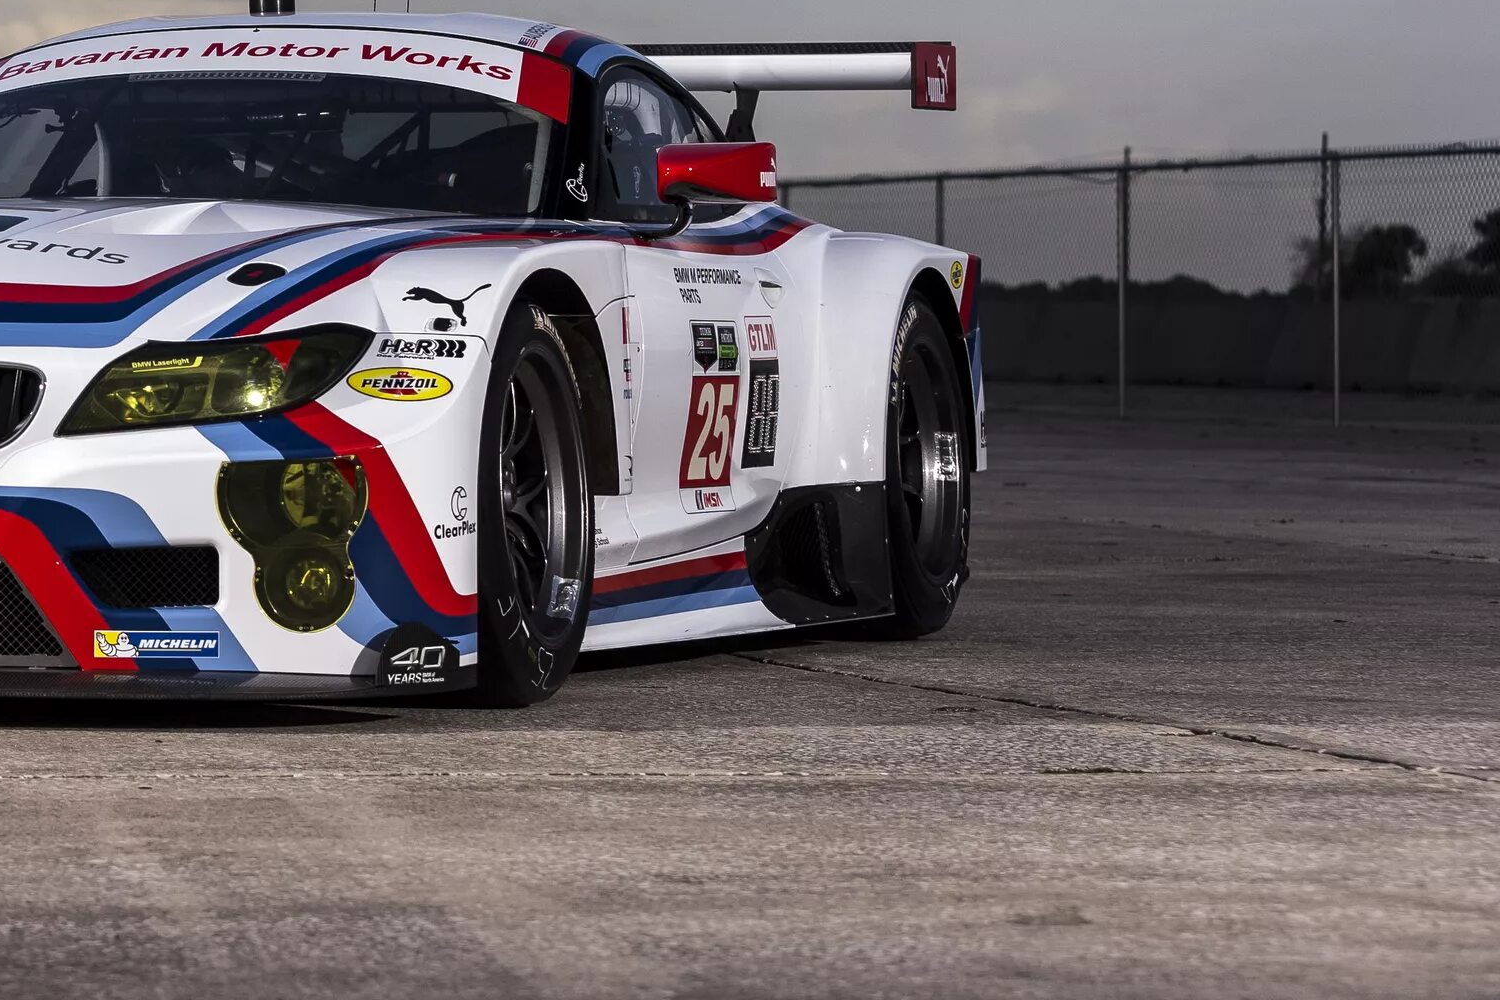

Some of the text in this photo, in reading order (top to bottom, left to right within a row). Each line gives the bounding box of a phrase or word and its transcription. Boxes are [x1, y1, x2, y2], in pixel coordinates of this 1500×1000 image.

[201, 42, 350, 58] Motor
[362, 44, 514, 81] Works
[673, 267, 742, 285] BMW M PERFORMANCE
[679, 288, 702, 304] PARTS
[380, 338, 437, 355] H&R
[748, 324, 776, 352] GTLM
[131, 358, 190, 369] BMW Laserlight
[361, 378, 438, 388] PENNZOIL
[687, 382, 735, 481] 25
[434, 520, 477, 540] ClearPlex
[139, 639, 217, 649] MICHELIN
[390, 645, 446, 670] 40
[387, 672, 422, 685] YEARS
